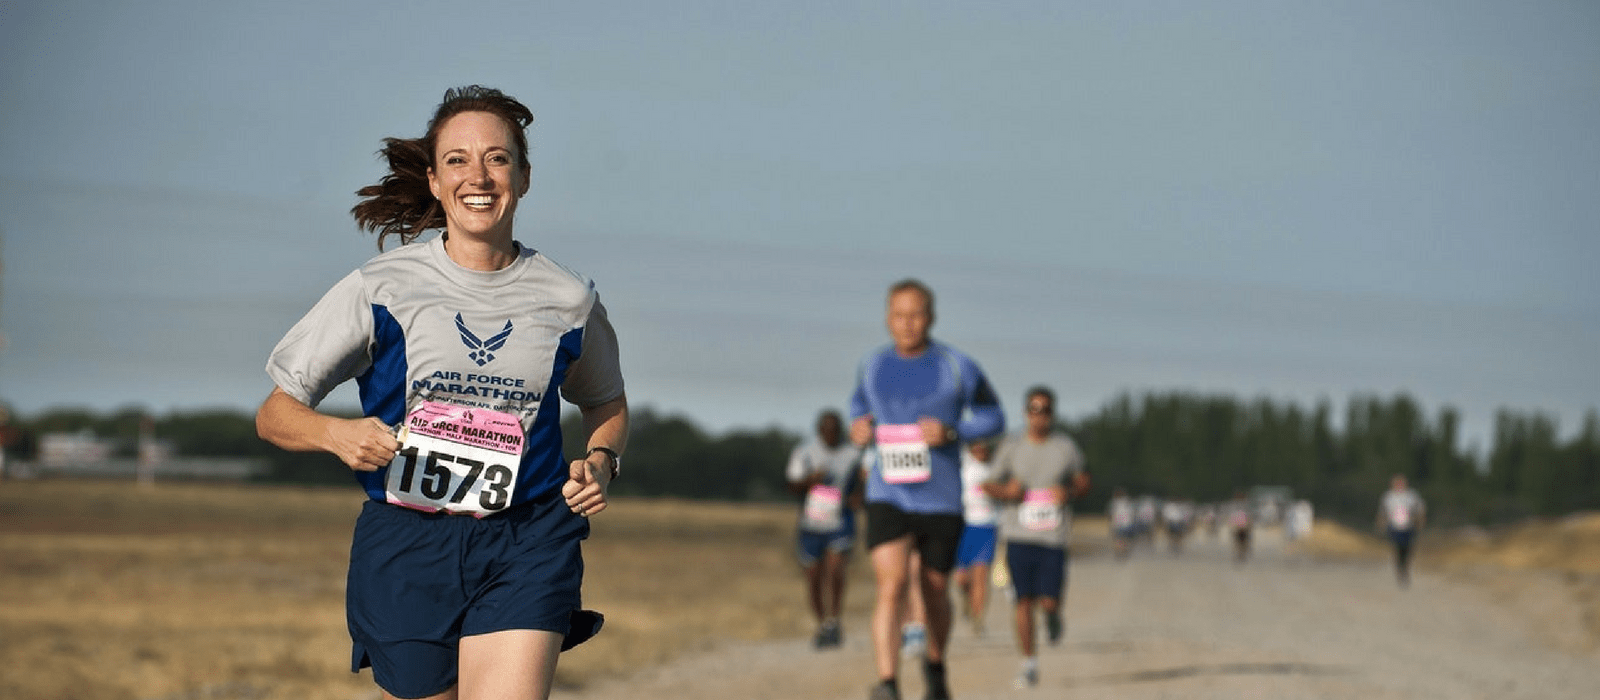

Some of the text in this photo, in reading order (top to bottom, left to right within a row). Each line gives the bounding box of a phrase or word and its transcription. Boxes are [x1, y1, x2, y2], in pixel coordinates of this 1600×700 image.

[412, 379, 541, 402] MARATHON
[431, 370, 525, 388] AIR FORCE
[432, 420, 460, 434] ORCE
[461, 426, 522, 446] MARATHON
[464, 436, 500, 449] MARATHON
[399, 446, 513, 510] 1573
